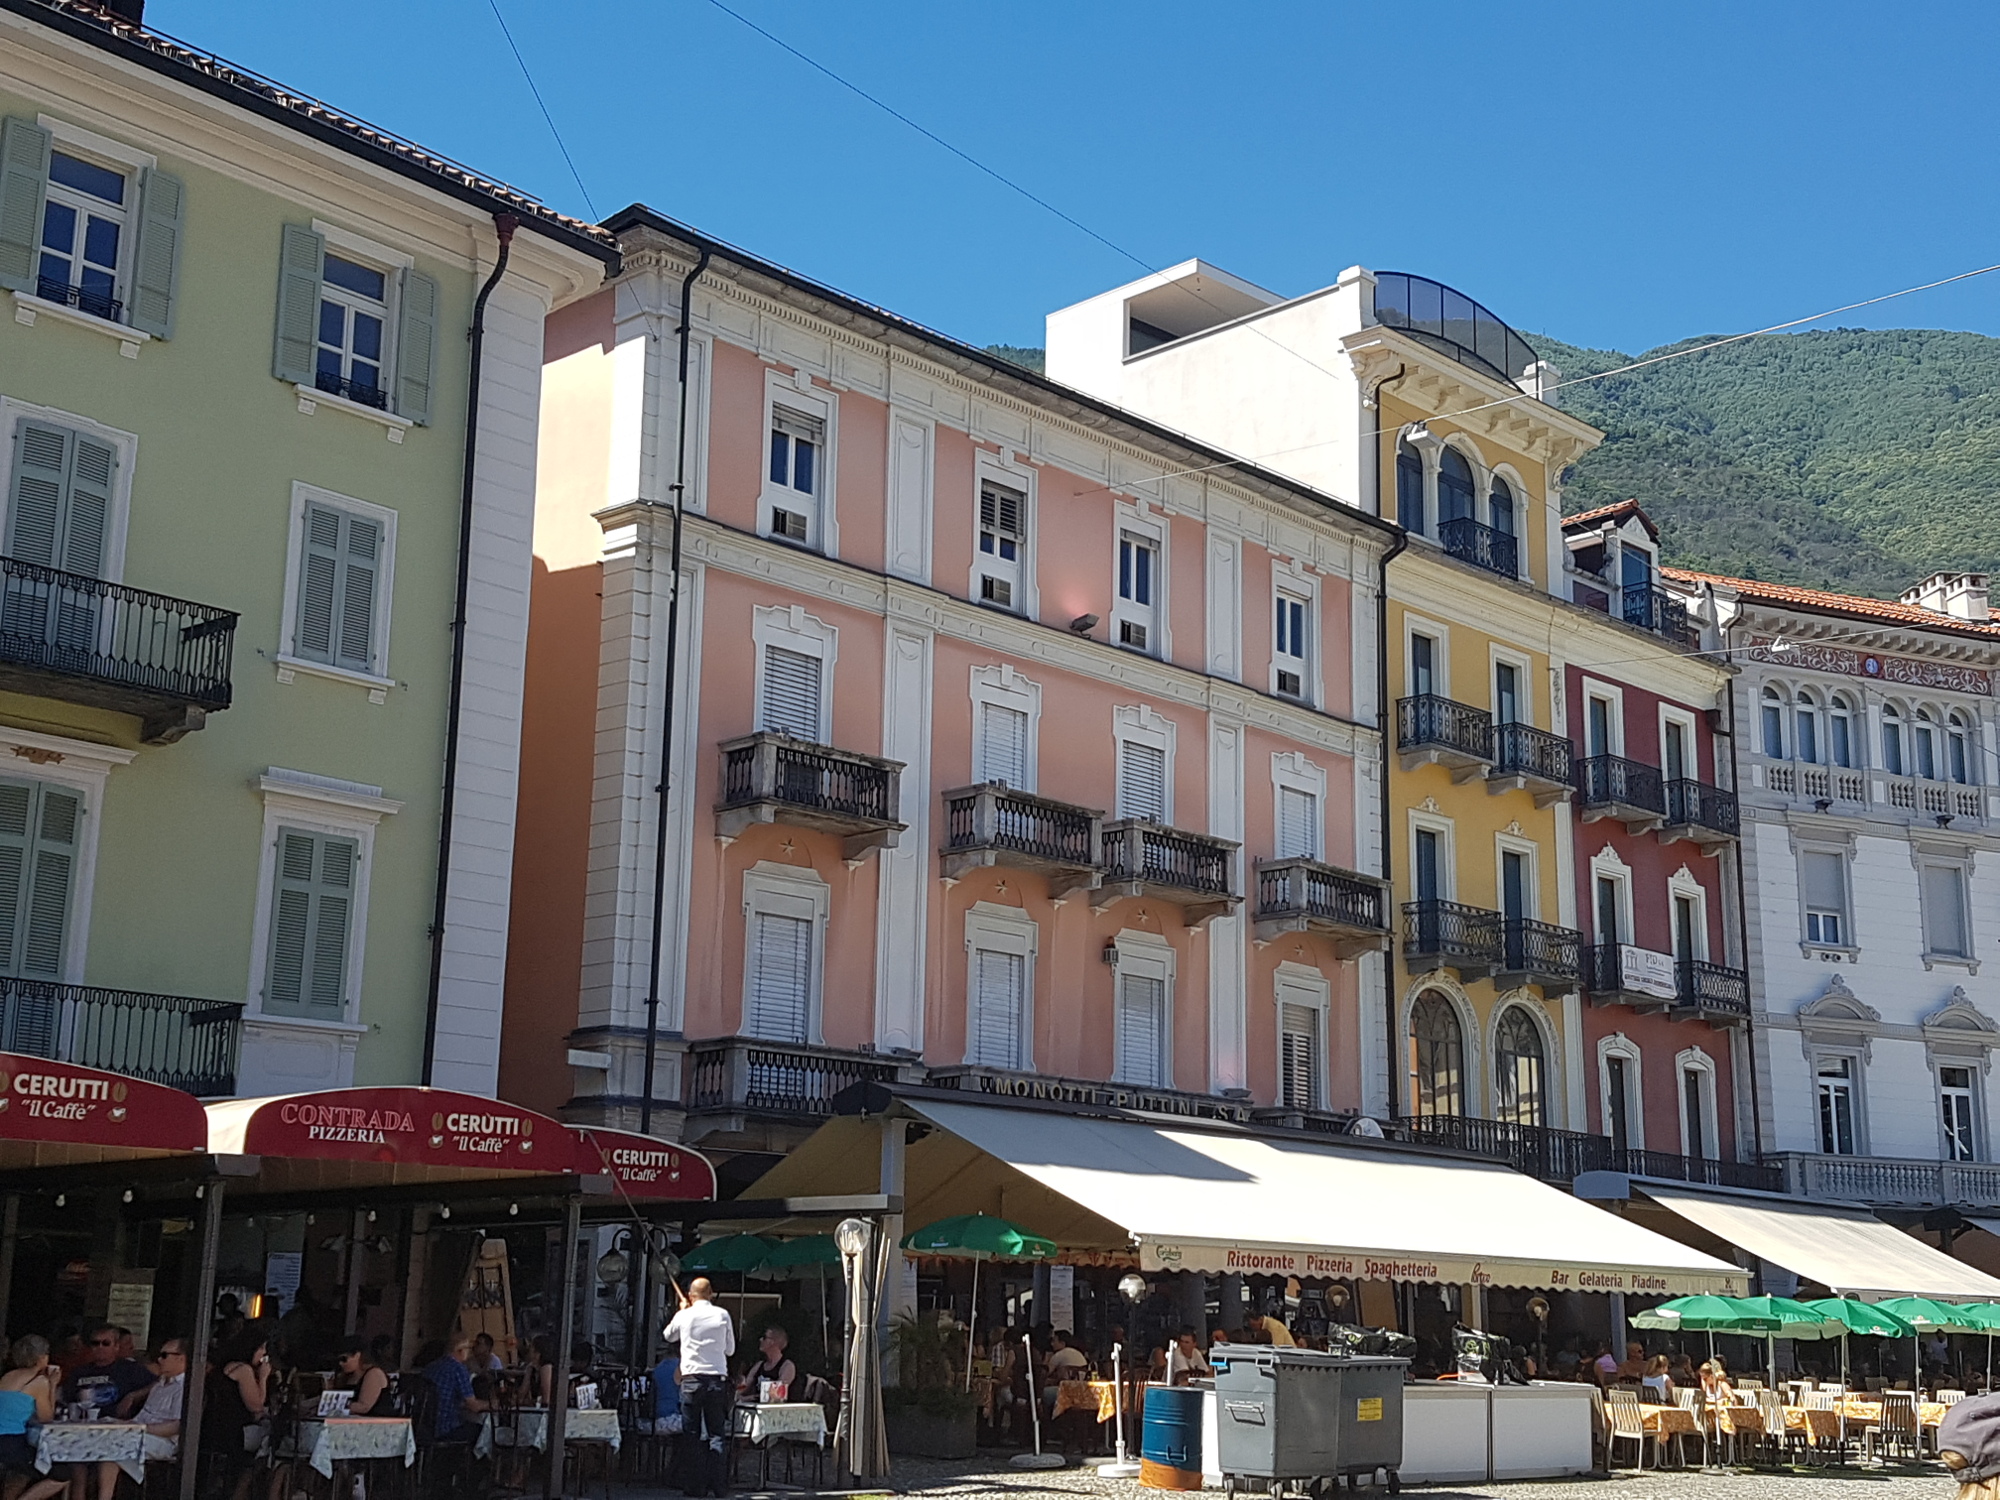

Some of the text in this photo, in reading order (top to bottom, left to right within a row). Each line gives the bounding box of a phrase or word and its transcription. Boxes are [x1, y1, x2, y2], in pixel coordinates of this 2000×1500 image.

[13, 1073, 109, 1100] CERUTTI
[995, 1077, 1096, 1104] MONOTTI
[280, 1103, 415, 1132] CONTRADA
[446, 1112, 519, 1135] CERUTTI
[308, 1125, 386, 1144] PIZZERIA
[612, 1149, 669, 1167] CERUTTI
[1226, 1250, 1438, 1279] Ristorante Pizzeria Spaghetteria
[1551, 1270, 1667, 1290] Bar Gelateria Piadine
